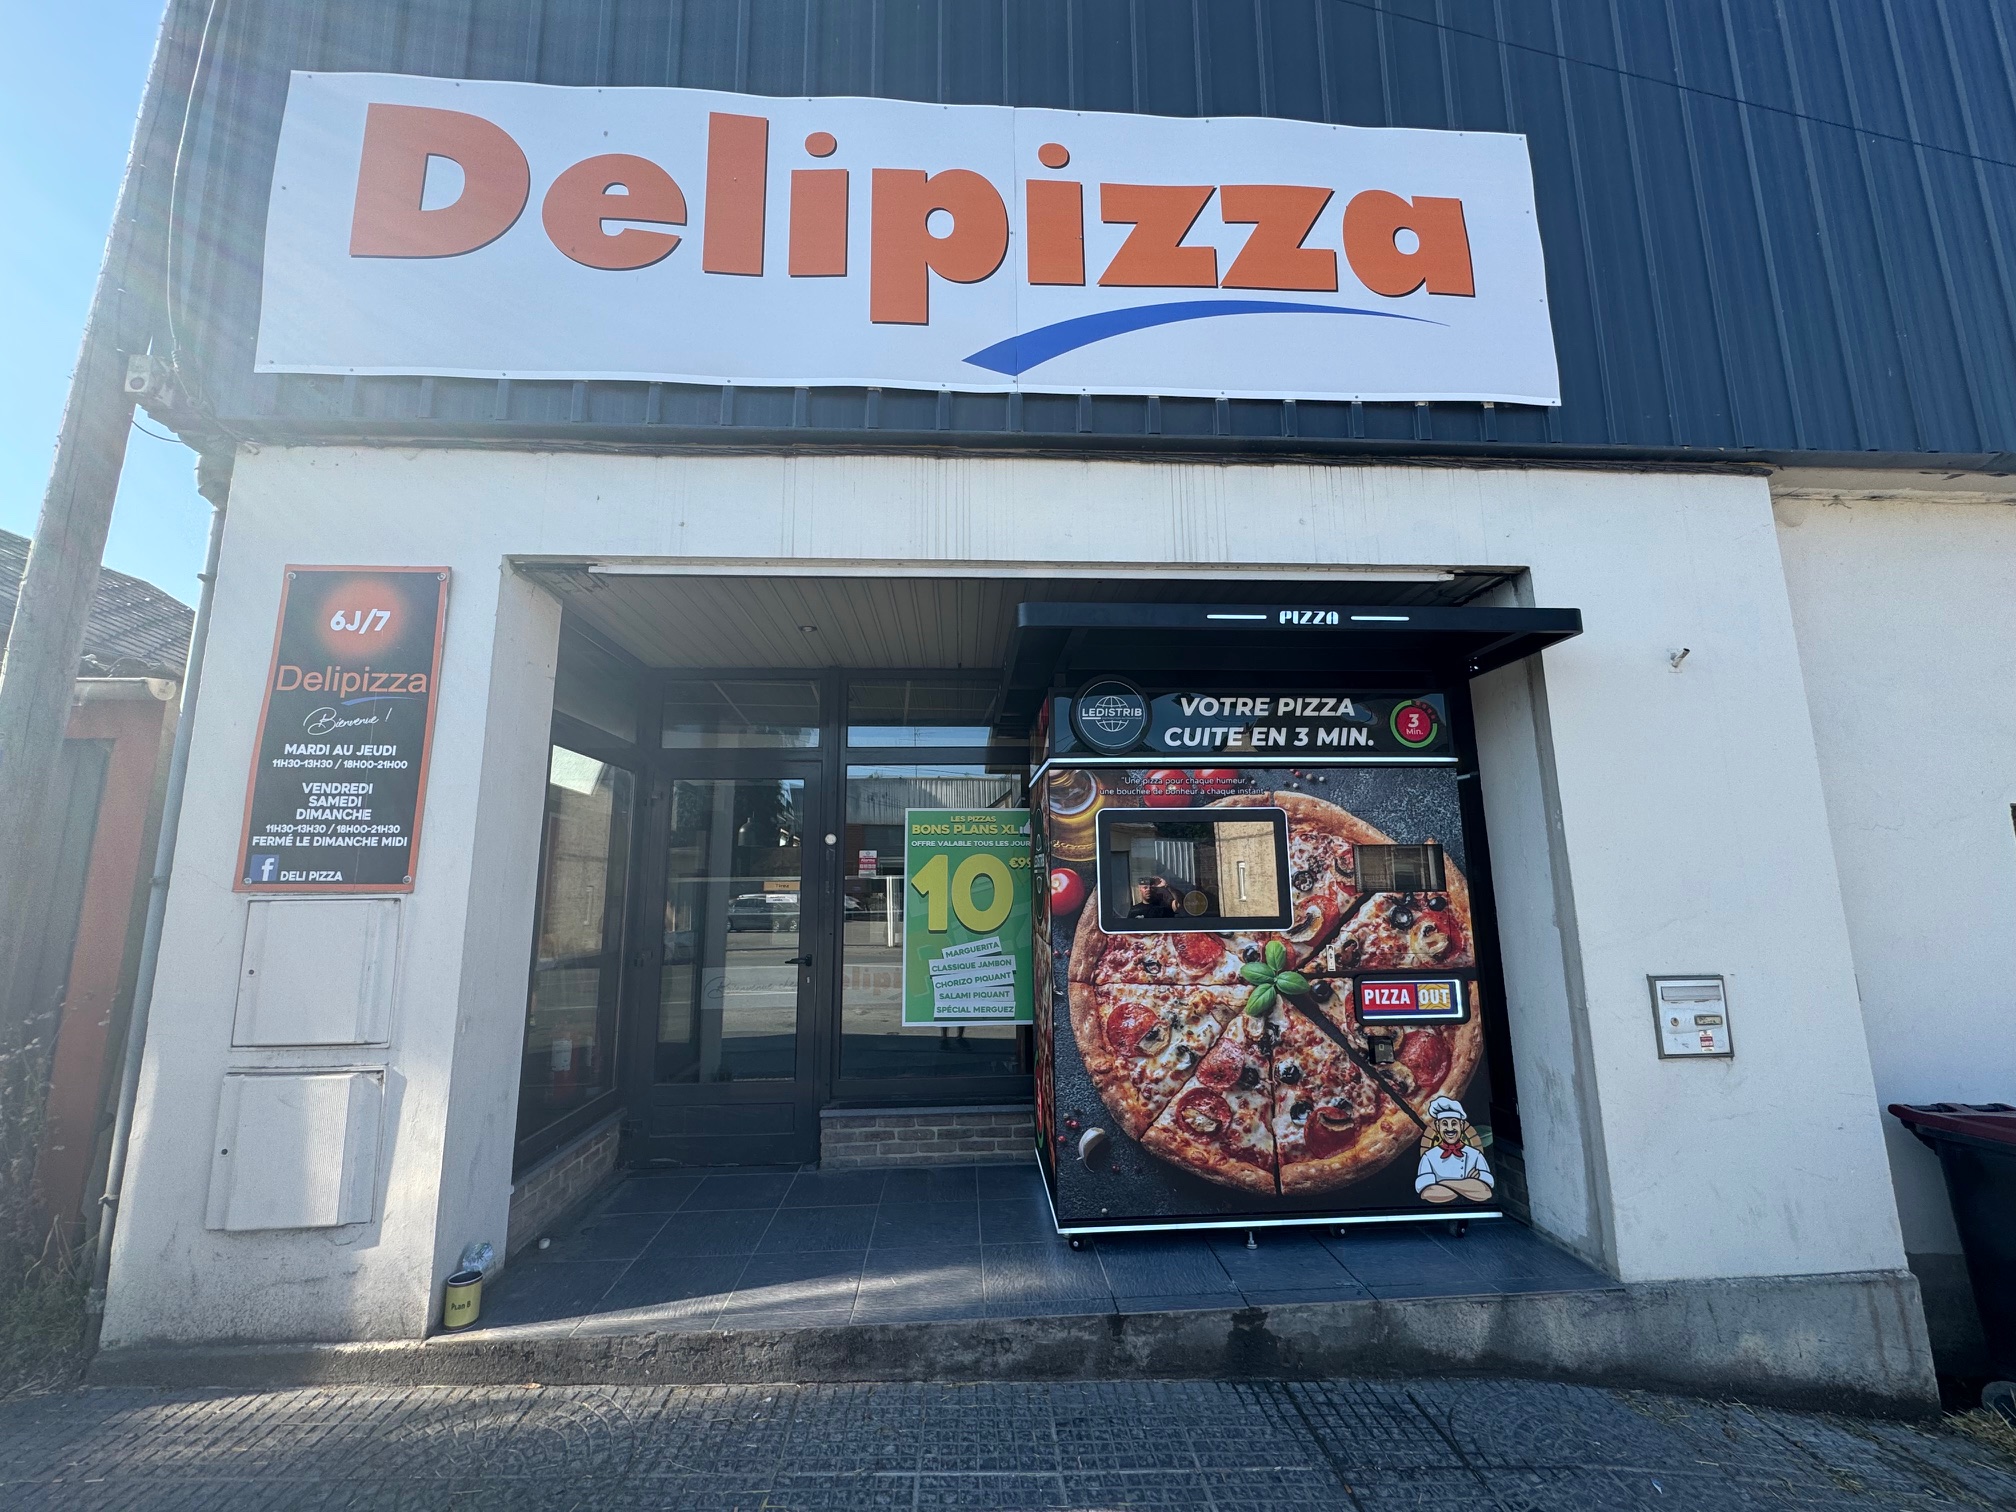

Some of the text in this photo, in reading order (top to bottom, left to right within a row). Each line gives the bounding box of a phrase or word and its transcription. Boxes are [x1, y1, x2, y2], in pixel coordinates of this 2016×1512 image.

[350, 102, 1476, 325] Delipizza
[330, 609, 390, 634] 6J/7
[1279, 610, 1339, 625] PIZZA
[276, 665, 427, 698] Delipizza
[1082, 708, 1142, 717] LEDISTRIB
[1180, 698, 1355, 716] VOTRE PIZZA
[303, 707, 379, 735] Bienvenue
[1407, 713, 1420, 728] 3
[1164, 727, 1375, 747] CUITE EN 3 MIN.
[284, 744, 396, 756] MARDI AU JEUDI
[272, 759, 333, 768] 11H30-13H30
[343, 760, 408, 769] 18H00-21H00
[302, 783, 373, 794] VENDREDI
[1142, 777, 1163, 787] pizza
[1165, 778, 1184, 787] pour
[1185, 777, 1214, 786] chaque
[1152, 787, 1163, 796] de
[1165, 787, 1198, 796] bonheur
[1206, 787, 1236, 796] chaque
[308, 796, 362, 807] SAMEDI
[296, 809, 372, 820] DIMANCHE
[967, 815, 996, 823] PIZZAS
[266, 824, 326, 833] 11H30-13H30
[336, 825, 400, 833] 18H00-21H30
[912, 824, 1018, 835] BONS PLANS XL
[252, 834, 408, 847] FERMÉ LE DIMANCHE MIDI
[280, 871, 306, 881] DELI
[308, 871, 343, 881] PIZZA
[911, 853, 1014, 933] 10
[945, 941, 1000, 958] MARGUERITA
[931, 959, 1012, 972] CLASSIQUE JAMBON
[935, 972, 1011, 989] CHORIZO PIQUANT
[1364, 988, 1449, 1005] PIZZA OUT
[936, 1005, 971, 1013] SPÉCIAL
